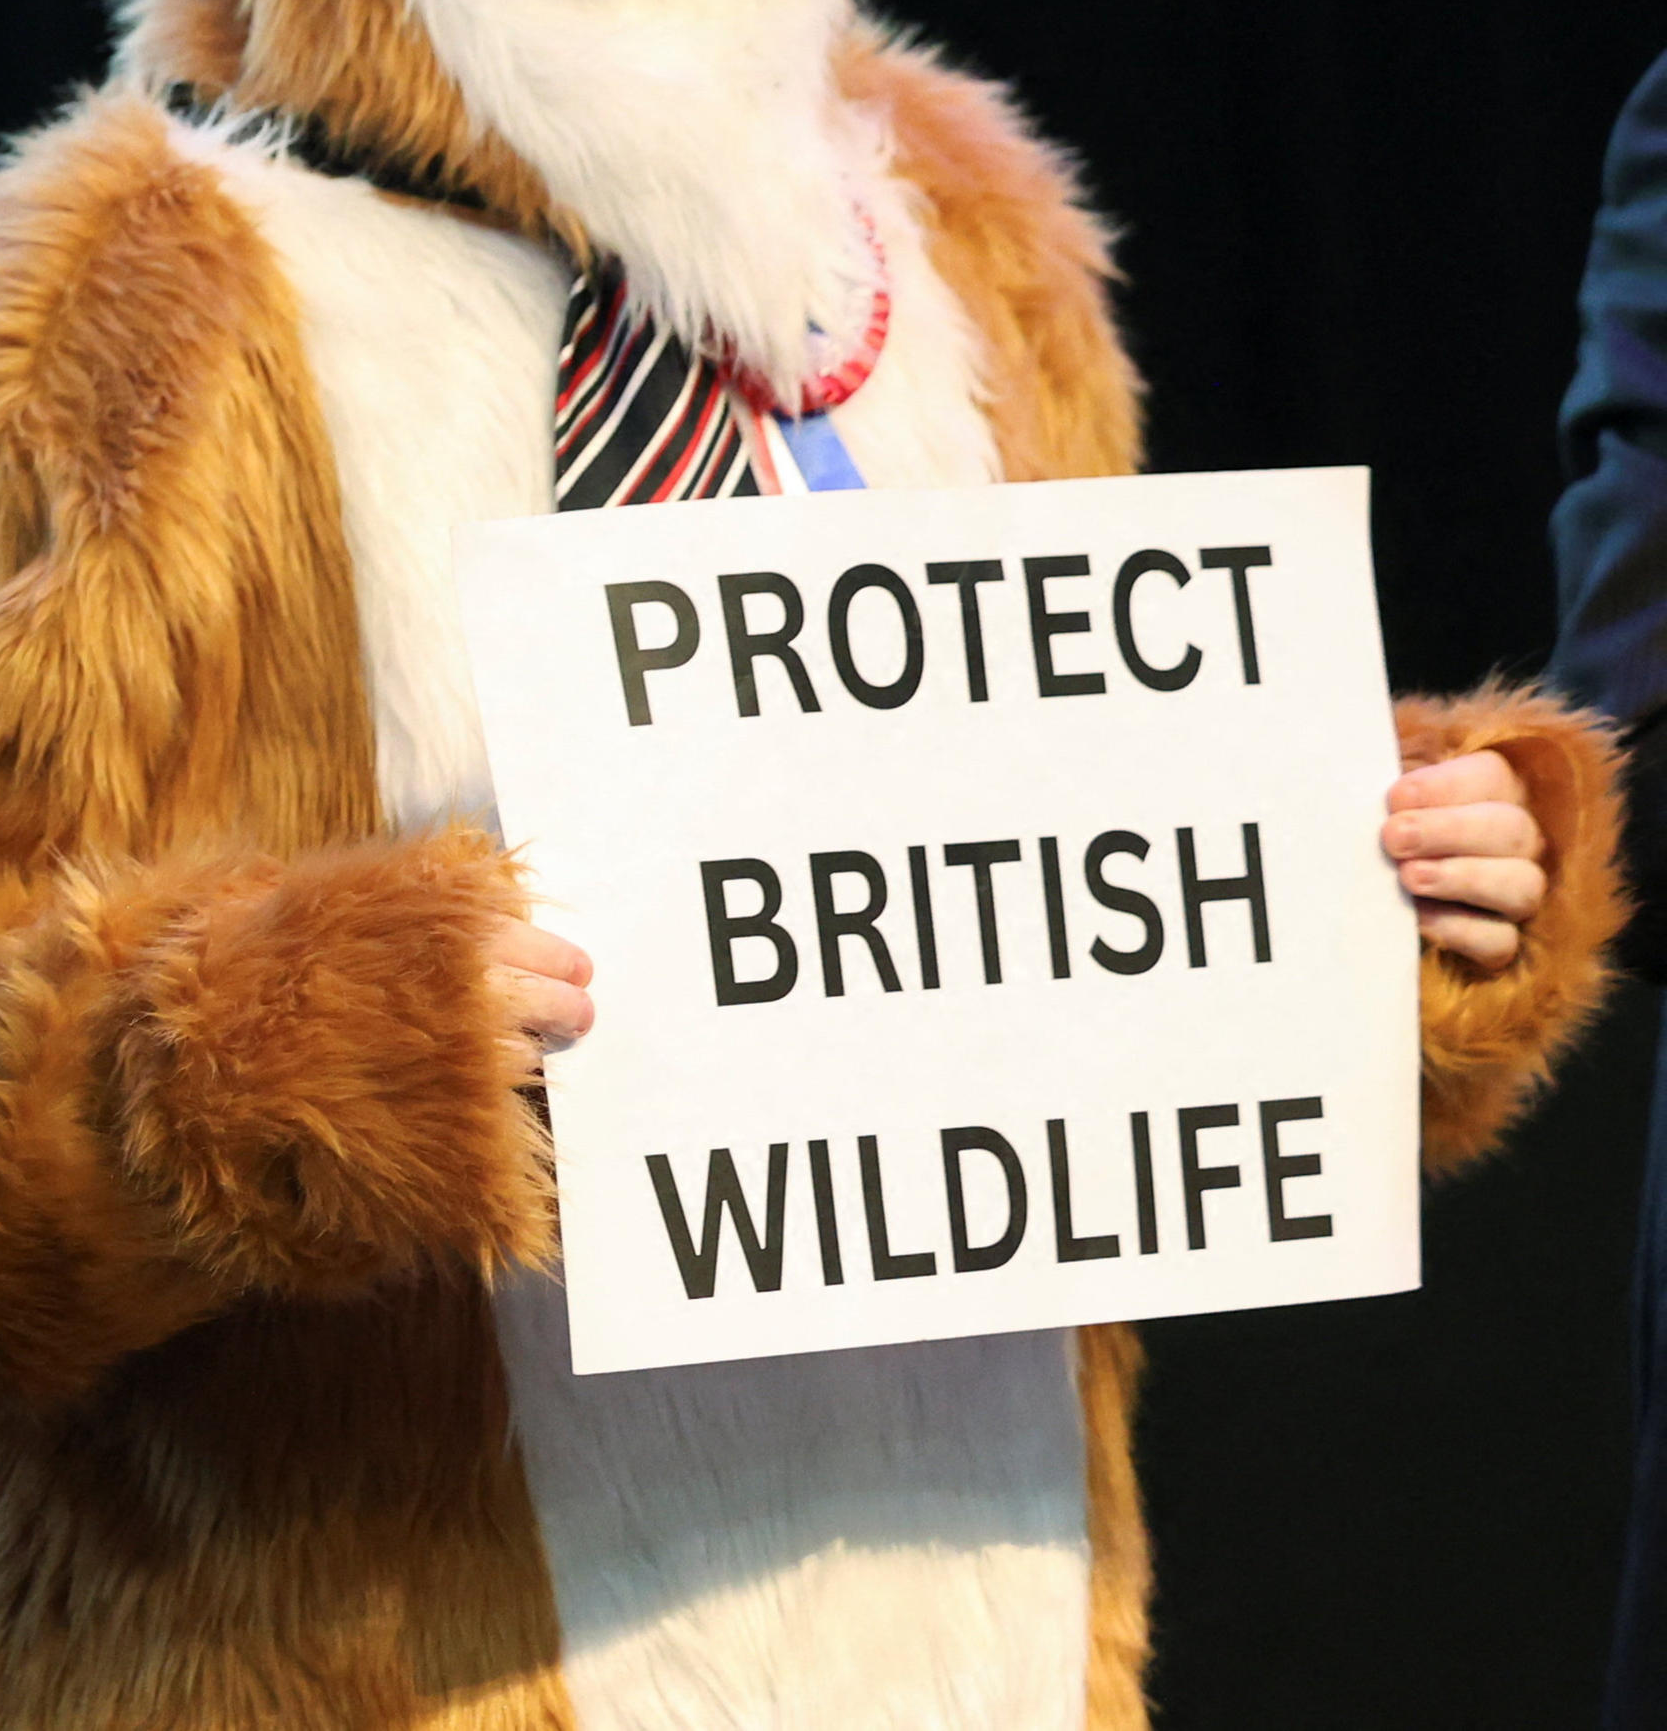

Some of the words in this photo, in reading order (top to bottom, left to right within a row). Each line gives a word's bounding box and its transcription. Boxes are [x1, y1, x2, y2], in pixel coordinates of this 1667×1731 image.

[605, 545, 1273, 726] PROTECT
[699, 822, 1272, 1007] BRITISH
[644, 1096, 1334, 1300] WILDLIFE
